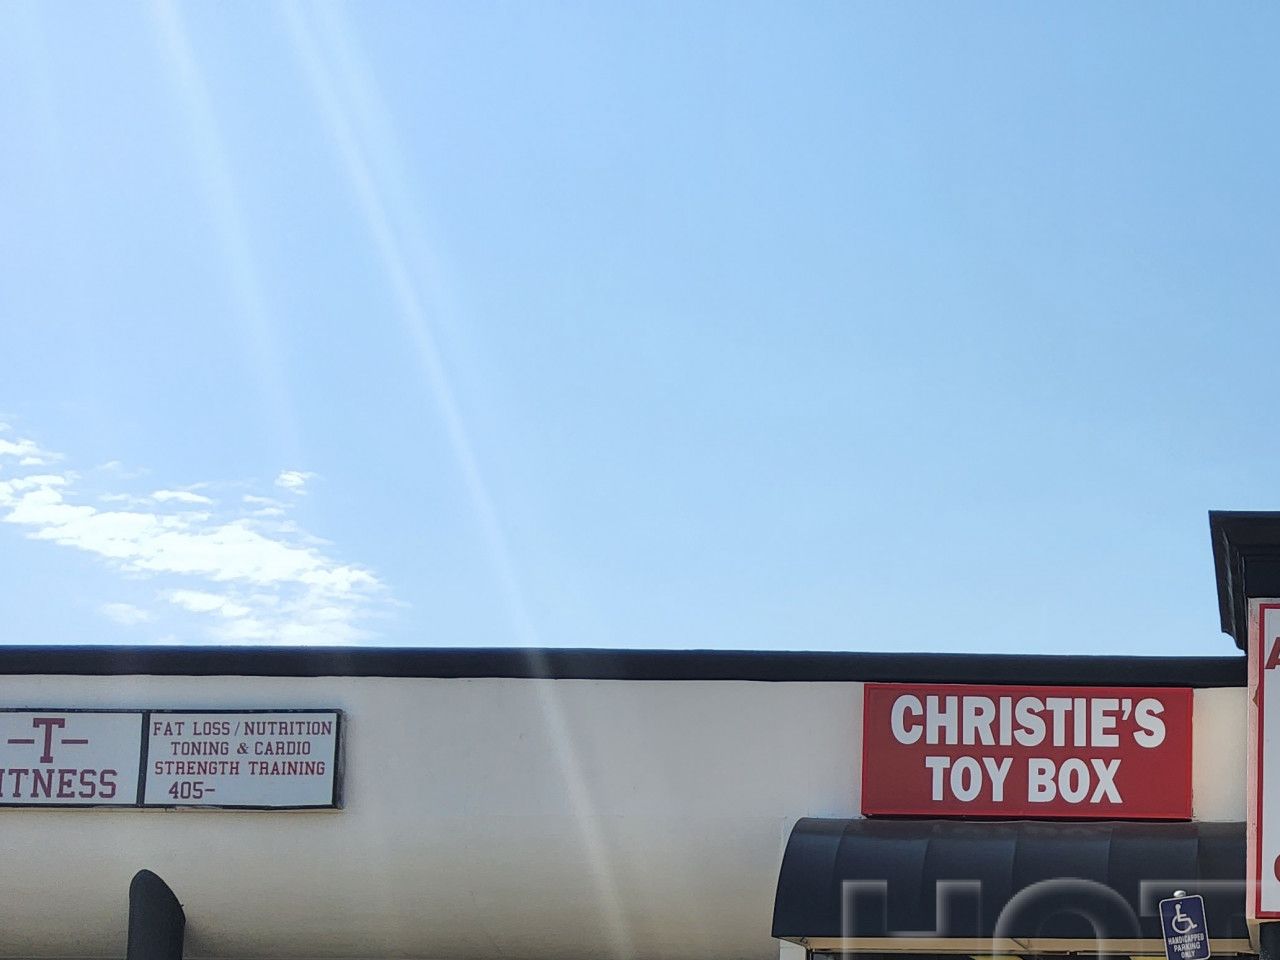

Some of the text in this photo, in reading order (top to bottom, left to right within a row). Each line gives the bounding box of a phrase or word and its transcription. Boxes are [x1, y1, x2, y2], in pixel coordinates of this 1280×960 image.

[153, 722, 185, 736] FAT
[193, 722, 231, 736] LOSS
[244, 722, 333, 736] NUTRITION
[890, 694, 1167, 749] CHRISTIE'S
[171, 741, 311, 756] TONING & CARDIO
[155, 761, 326, 776] STRENGTH TRAINING
[925, 755, 1123, 804] TOY BOX
[168, 781, 216, 800] 405-
[1167, 932, 1205, 946] HANDICAPPED
[1173, 941, 1201, 953] PARKING
[1181, 950, 1196, 959] ONLY
